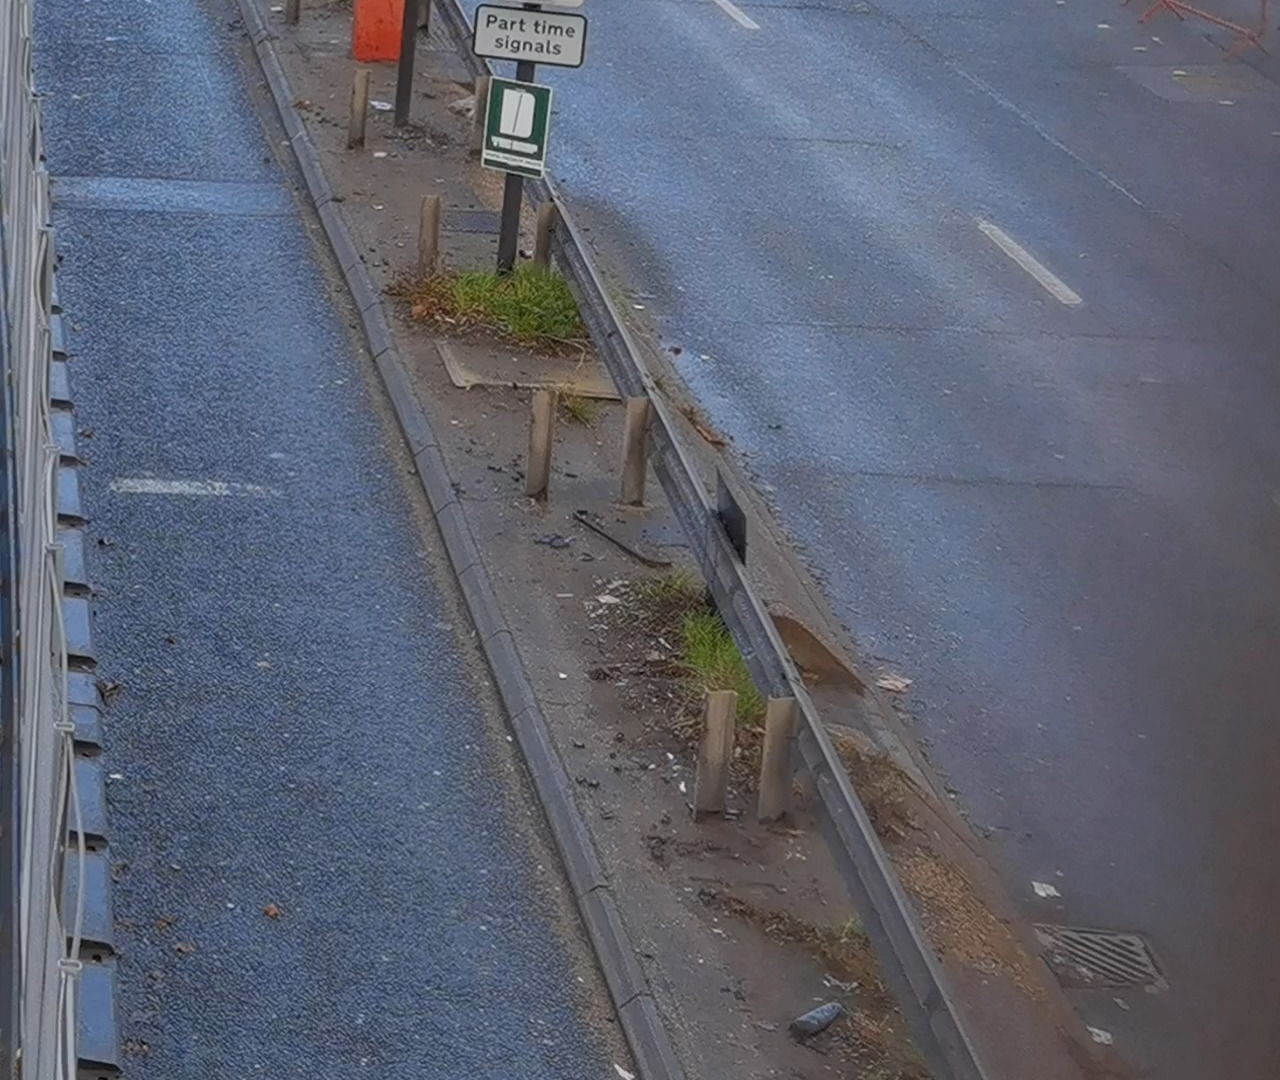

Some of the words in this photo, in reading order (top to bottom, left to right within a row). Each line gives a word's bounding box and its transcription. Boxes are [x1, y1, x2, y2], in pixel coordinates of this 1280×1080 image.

[485, 14, 527, 33] Part
[533, 20, 576, 38] time
[494, 35, 562, 56] signals
